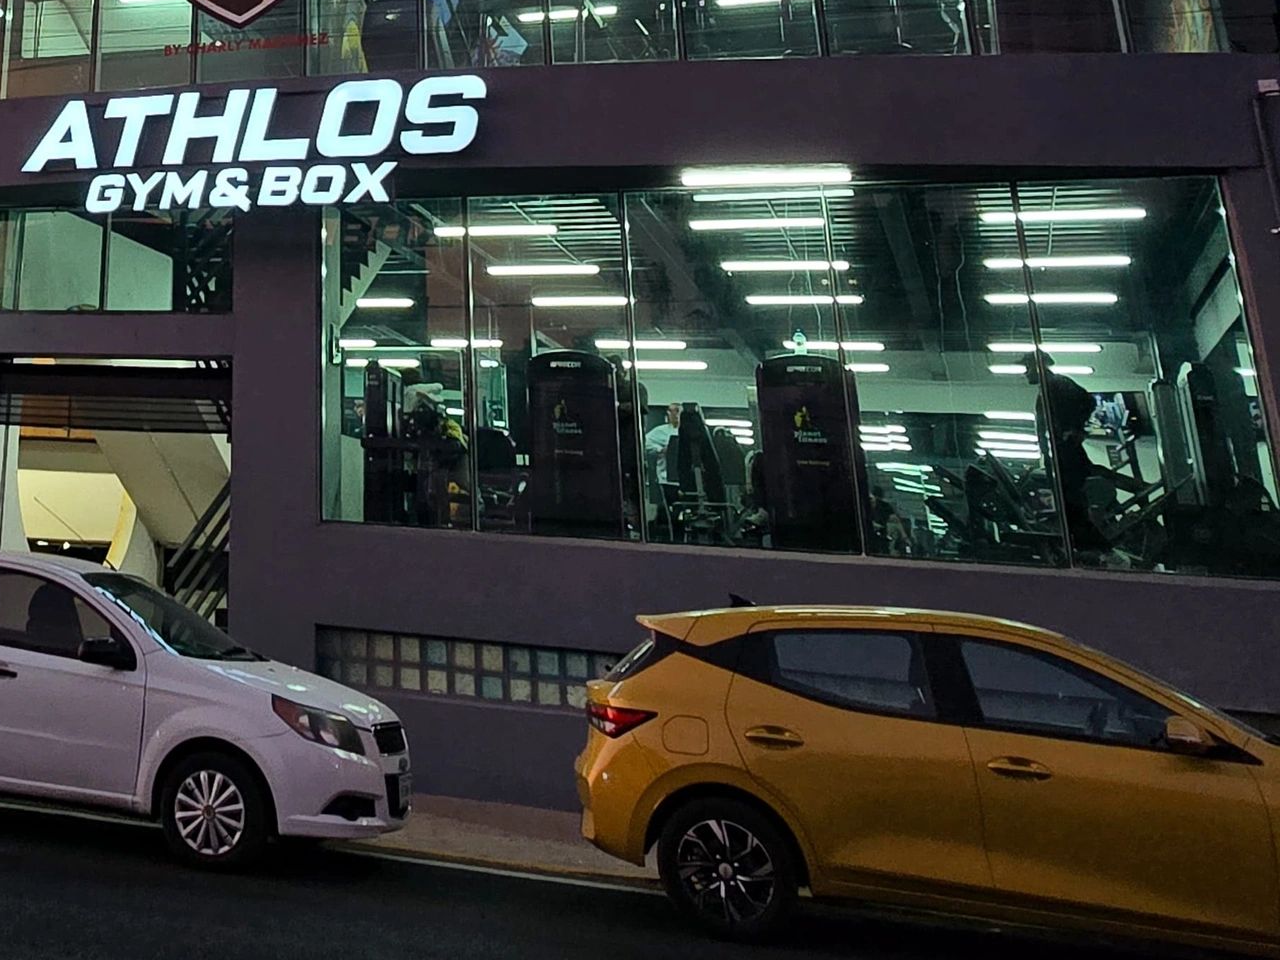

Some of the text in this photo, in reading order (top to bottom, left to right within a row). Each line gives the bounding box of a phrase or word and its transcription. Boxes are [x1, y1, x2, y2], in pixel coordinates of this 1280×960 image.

[164, 44, 182, 57] BY
[187, 40, 242, 55] CHARLY
[21, 74, 488, 173] ATHLOS
